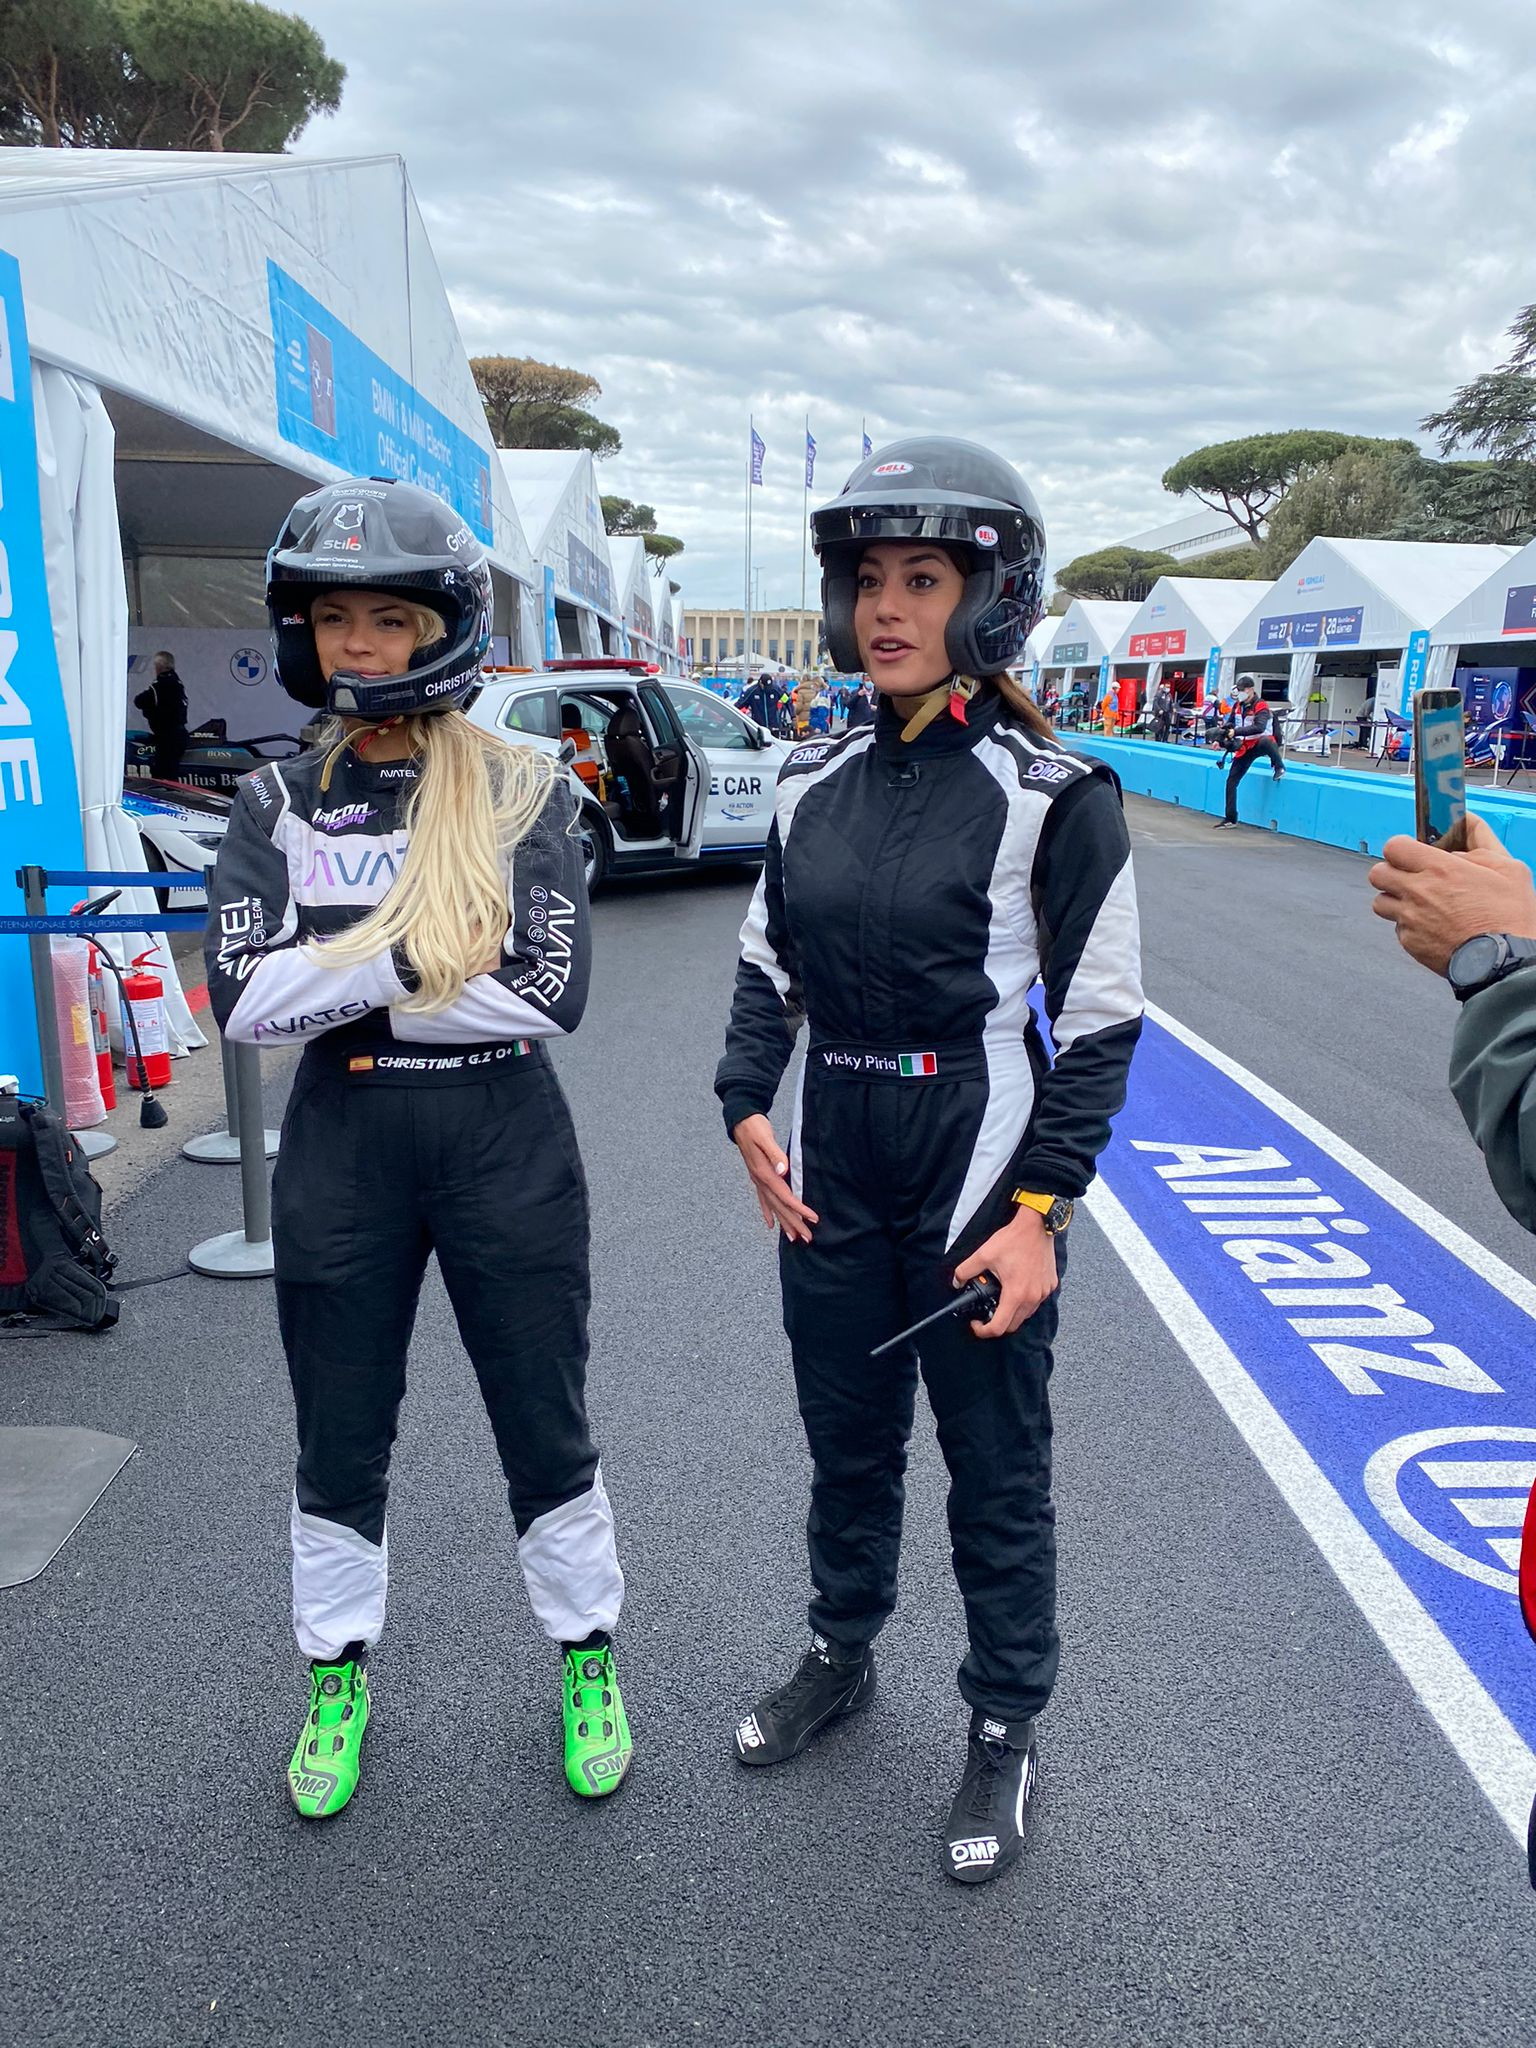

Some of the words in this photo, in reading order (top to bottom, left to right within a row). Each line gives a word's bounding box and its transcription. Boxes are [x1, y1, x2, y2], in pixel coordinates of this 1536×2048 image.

[877, 464, 907, 473] BELL
[979, 530, 995, 541] BELL
[425, 663, 478, 696] CHRISTINE
[207, 750, 232, 758] BOSS
[790, 745, 830, 763] OMP
[178, 773, 217, 786] ulius
[380, 769, 418, 778] AVATEL
[1027, 760, 1069, 781] OMP
[724, 776, 762, 796] CAR
[377, 1056, 464, 1070] CHRISTINE
[823, 1052, 861, 1070] Vicky
[865, 1055, 897, 1070] Piria
[1129, 1139, 1507, 1396] Allianz
[738, 1715, 761, 1749] OMP
[984, 1721, 1007, 1737] OMP
[951, 1839, 1000, 1862] OMP
